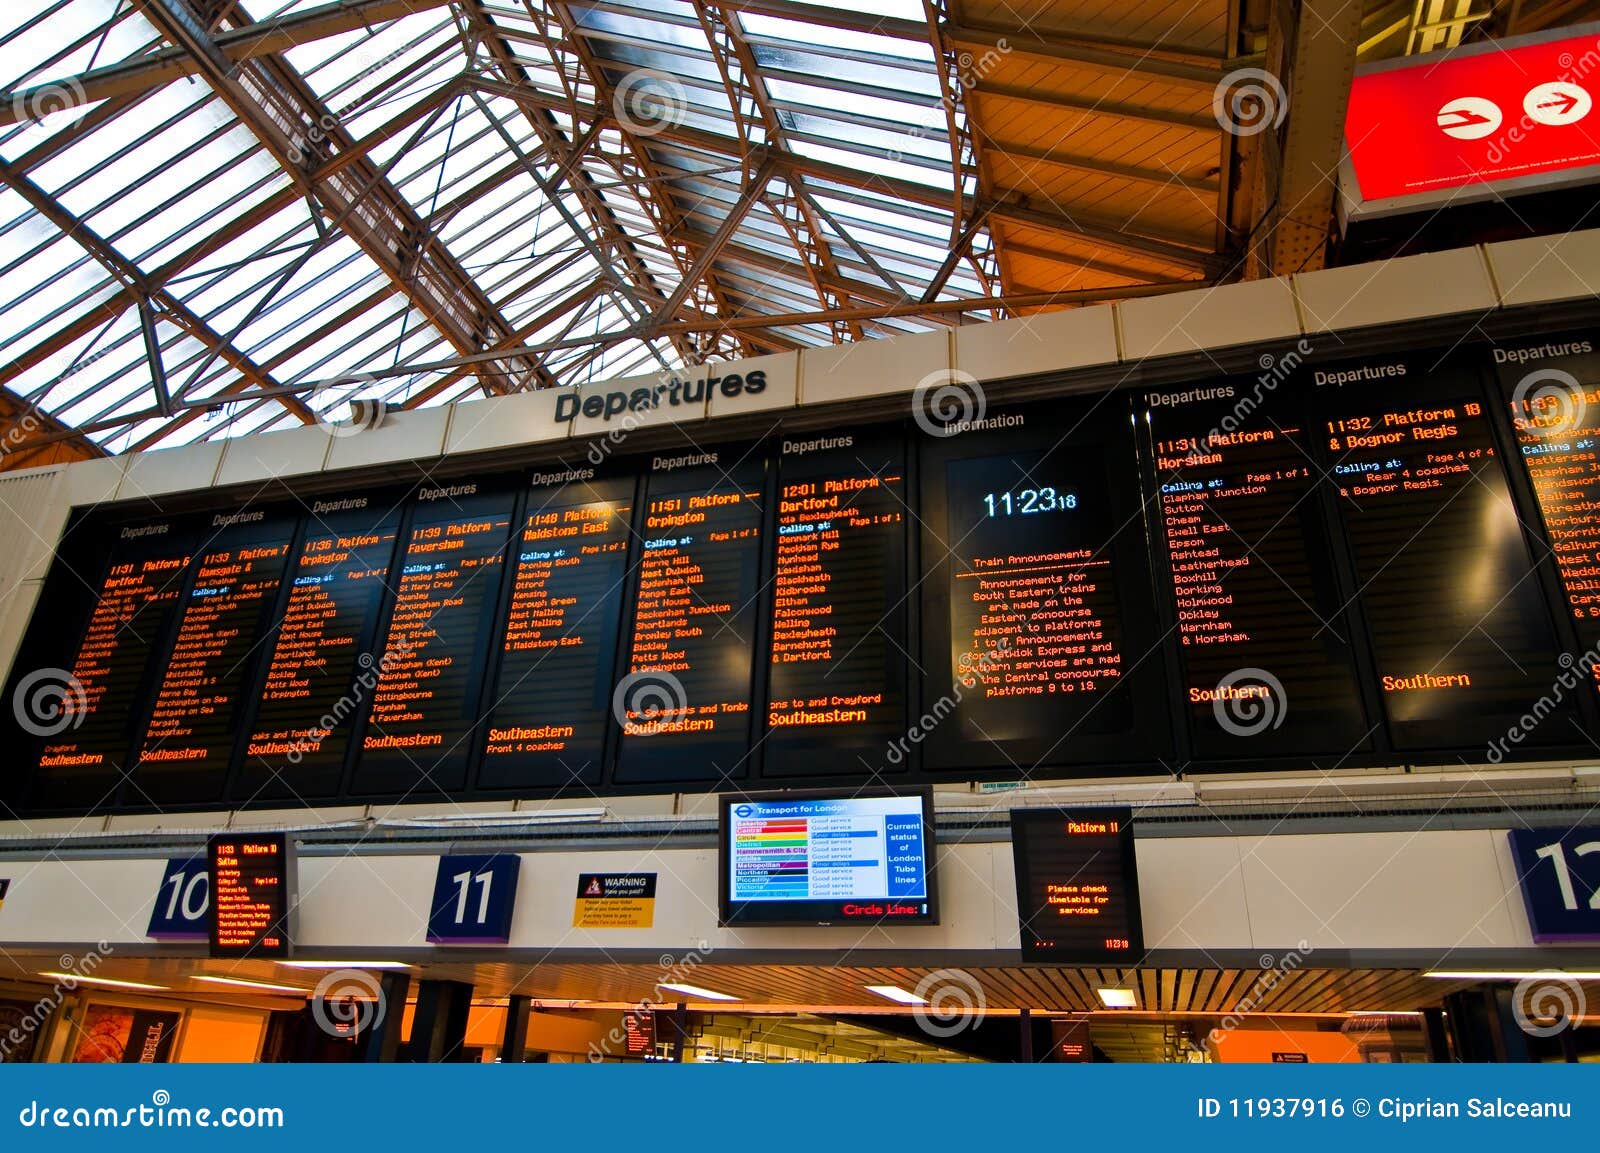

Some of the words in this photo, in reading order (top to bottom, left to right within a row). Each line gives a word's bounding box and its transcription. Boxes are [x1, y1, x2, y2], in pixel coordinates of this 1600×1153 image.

[1493, 341, 1593, 364] Departures
[1314, 363, 1406, 386] Departures
[555, 371, 767, 423] Departures
[1150, 386, 1235, 407] Departures
[944, 414, 1024, 434] Information
[1327, 417, 1372, 434] 11:32
[1384, 408, 1455, 426] Platform
[1158, 438, 1197, 454] 11:31
[1208, 430, 1274, 447] Platform
[1330, 438, 1340, 450] &
[1347, 431, 1405, 448] Bognor
[1413, 424, 1458, 440] Regis
[783, 436, 853, 455] Departures
[652, 453, 718, 471] Departures
[1158, 452, 1222, 469] Horsham
[1427, 454, 1453, 463] Page
[1526, 452, 1596, 467] Battersea
[1335, 463, 1380, 474] Calling
[1366, 473, 1396, 482] Rear
[1416, 463, 1470, 477] coaches
[532, 468, 594, 486] Departures
[1248, 473, 1271, 482] Page
[419, 484, 477, 501] Departures
[783, 484, 815, 498] 12:01
[825, 478, 878, 493] Platform
[1161, 482, 1203, 493] Calling
[1163, 492, 1209, 504] Clapham
[1214, 485, 1266, 497] Junction
[1354, 484, 1398, 496] Bognor
[1404, 479, 1443, 490] Regis.
[313, 498, 367, 514] Departures
[650, 499, 681, 512] 11:51
[689, 494, 740, 508] Platform
[781, 496, 838, 512] Dartford
[984, 488, 1056, 517] 11:23
[1164, 504, 1203, 514] Sutton
[213, 511, 264, 526] Departures
[528, 513, 558, 526] 11:48
[565, 509, 612, 522] Platform
[648, 512, 705, 528] Orpington
[1166, 516, 1201, 525] Cheam
[121, 523, 169, 539] Departures
[413, 527, 441, 540] 11:39
[447, 522, 491, 535] Platform
[524, 526, 578, 540] Maidstone
[582, 521, 609, 533] East
[1168, 527, 1198, 537] Ewell
[1203, 524, 1231, 533] East
[336, 536, 378, 549] Platform
[408, 540, 465, 554] Faversham
[1169, 539, 1204, 549] Epsom
[239, 549, 277, 560] Platform
[300, 552, 348, 566] Orpington
[974, 559, 1003, 568] Train
[1008, 549, 1092, 564] Announcements
[1171, 548, 1219, 560] Ashtead
[143, 559, 179, 571] Platform
[199, 566, 241, 577] Ramsgate
[1172, 557, 1249, 572] Leatherhead
[105, 575, 144, 588] Dartford
[980, 575, 1062, 589] Announcements
[1068, 572, 1087, 581] for
[1174, 572, 1217, 584] Boxhill
[776, 584, 826, 596] Kidbrooke
[973, 592, 1004, 601] South
[1009, 587, 1054, 598] Eastern
[1060, 584, 1096, 593] trains
[1176, 585, 1222, 595] Dorking
[689, 604, 731, 614] Junction
[1013, 599, 1040, 609] made
[1063, 596, 1082, 604] the
[1177, 595, 1233, 608] Holmwood
[775, 605, 832, 618] Falconwood
[981, 614, 1026, 624] Eastern
[1031, 608, 1092, 620] concourse
[1179, 610, 1219, 620] Ockley
[774, 628, 836, 640] Bexleyheath
[974, 626, 1022, 637] adjacent
[1045, 619, 1101, 632] platforms
[1181, 621, 1232, 632] Warnham
[773, 639, 832, 651] Barnehurst
[1017, 631, 1102, 645] Announcements
[1196, 633, 1250, 644] Horsham.
[991, 649, 1033, 659] Gatwick
[1038, 644, 1085, 656] Express
[1092, 642, 1112, 652] and
[958, 663, 1010, 674] Southern
[1016, 658, 1067, 669] services
[1073, 656, 1093, 665] are
[1099, 654, 1120, 663] mad
[981, 675, 1000, 684] the
[1006, 672, 1049, 682] Central
[1055, 668, 1121, 680] concourse,
[1383, 672, 1471, 692] Southern
[987, 685, 1043, 698] platforms
[1190, 685, 1269, 701] Southern
[831, 694, 881, 705] Crayford
[769, 709, 866, 726] Southeastern
[489, 724, 573, 742] Southeastern
[624, 719, 714, 734] Southeastern
[248, 741, 320, 754] Southeastern
[364, 733, 442, 749] Southeastern
[40, 754, 102, 767] Southeastern
[139, 749, 207, 762] Southeastern
[758, 806, 797, 815] Transport
[1068, 822, 1106, 833] Platform
[1111, 822, 1118, 832] 11
[604, 878, 646, 886] WARNING
[1082, 885, 1108, 893] check
[166, 872, 209, 920] 10
[453, 870, 494, 924] 11
[1048, 896, 1090, 904] timetable
[843, 905, 882, 915] Circle
[887, 904, 918, 914] Line:
